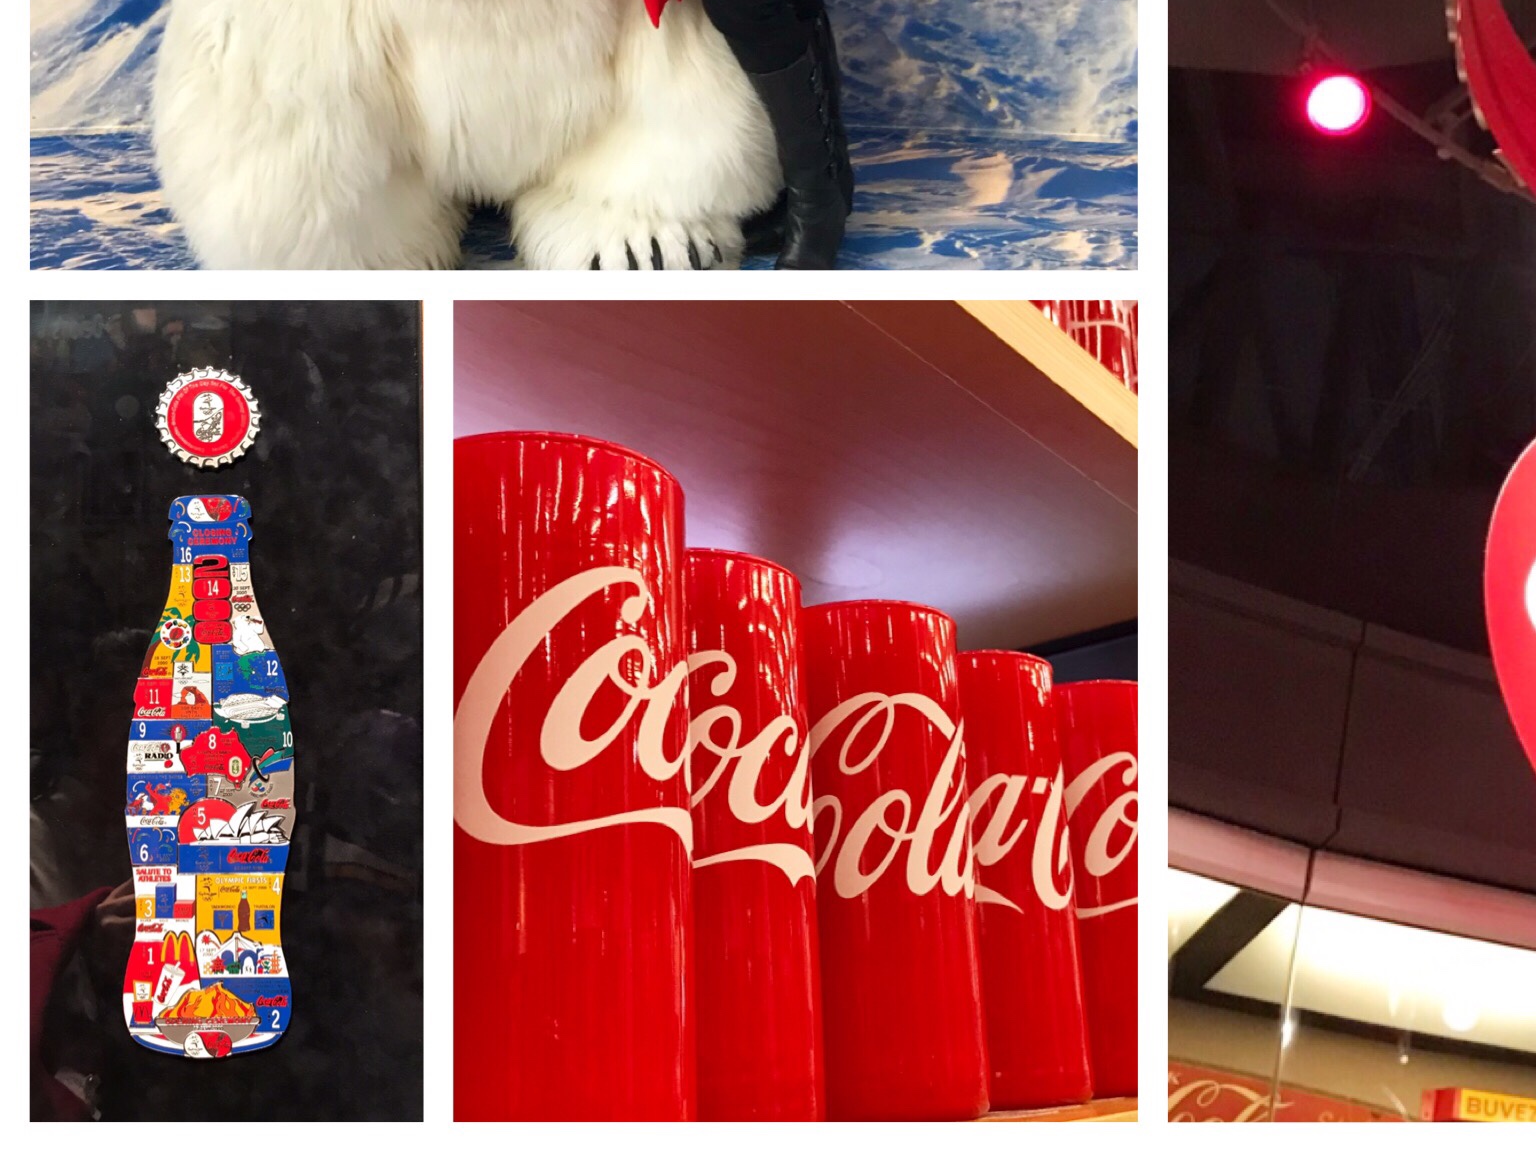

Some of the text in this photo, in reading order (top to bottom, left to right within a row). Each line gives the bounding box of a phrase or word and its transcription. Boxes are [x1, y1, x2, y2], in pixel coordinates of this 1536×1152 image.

[192, 528, 232, 537] CLOSING
[187, 537, 238, 546] CEREMONY
[180, 547, 192, 563] 16
[179, 566, 191, 583] 13
[236, 565, 249, 582] 15
[207, 580, 219, 596] 14
[266, 659, 278, 676] 12
[149, 688, 160, 705] 11
[137, 706, 166, 717] Coca-Cola
[139, 721, 146, 738] 9
[208, 733, 217, 749] 8
[282, 731, 293, 747] 10
[144, 752, 174, 760] RADIO
[213, 777, 222, 796] 7
[140, 817, 165, 826] Coca-Cola
[197, 807, 206, 825] 5
[140, 843, 149, 862] 6
[226, 848, 270, 864] Coca-Cola
[215, 876, 244, 884] OLYMPIC
[272, 877, 280, 895] 4
[144, 899, 153, 917] 3
[147, 947, 154, 965] 1
[256, 995, 288, 1007] Coca-Cola
[271, 1009, 281, 1029] 2
